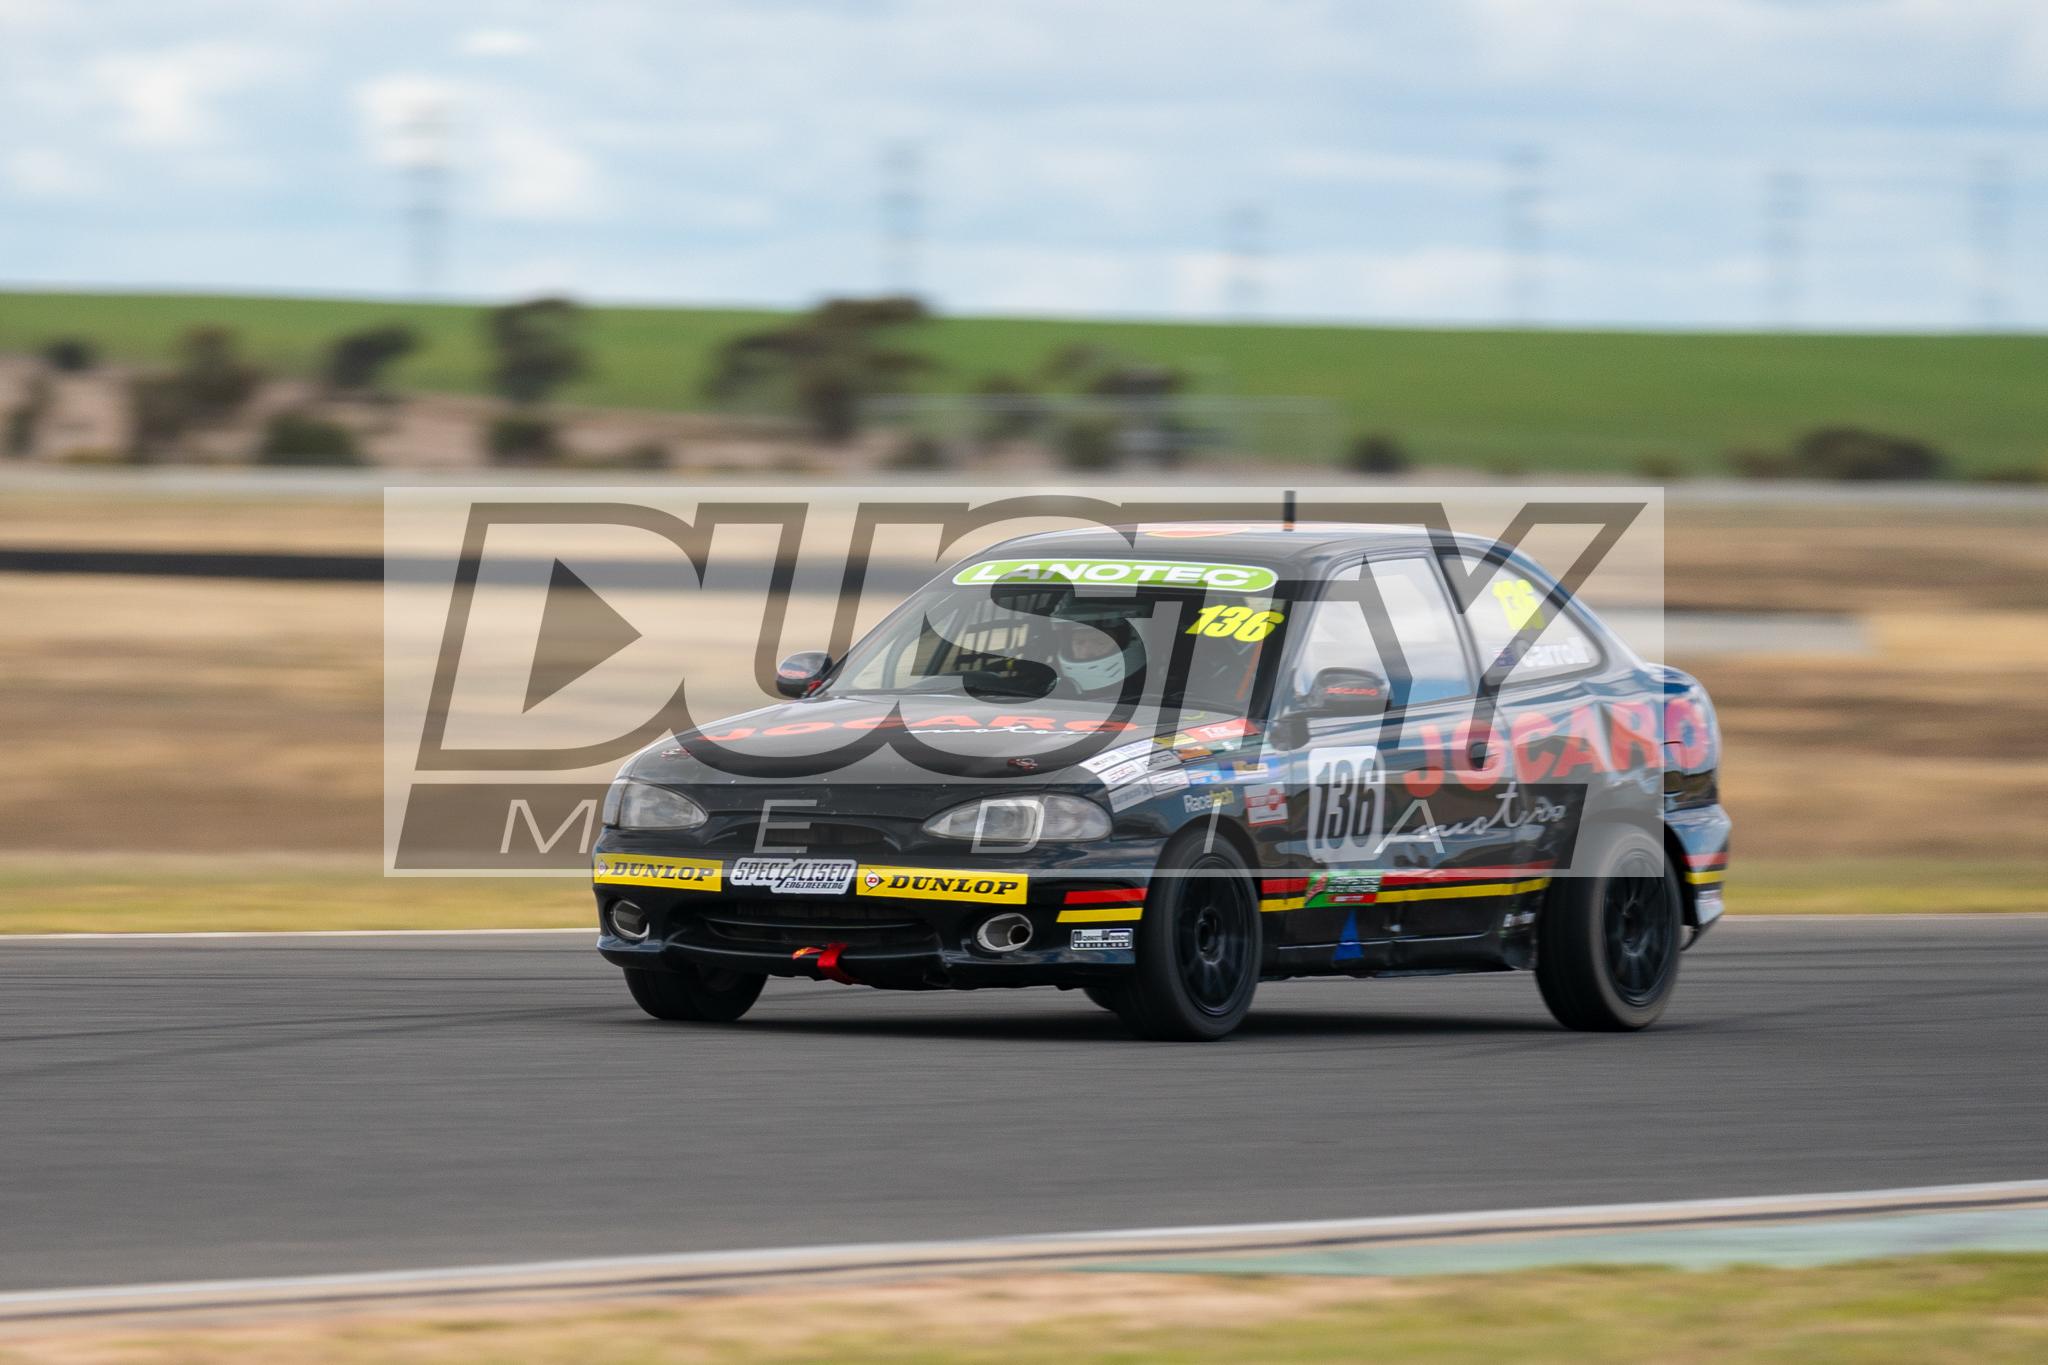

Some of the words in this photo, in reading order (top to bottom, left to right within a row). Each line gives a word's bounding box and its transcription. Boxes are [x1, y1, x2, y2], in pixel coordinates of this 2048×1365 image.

[974, 563, 1252, 586] LANOTEC
[1185, 604, 1285, 642] 136
[696, 714, 1137, 741] JOCARO
[1404, 698, 1709, 797] JOCARO
[1315, 758, 1380, 850] 136
[611, 861, 714, 881] DUNLOP
[735, 861, 851, 887] SPECIALISED
[784, 881, 844, 889] ENGINEERING
[888, 875, 1018, 895] DUNLOP
